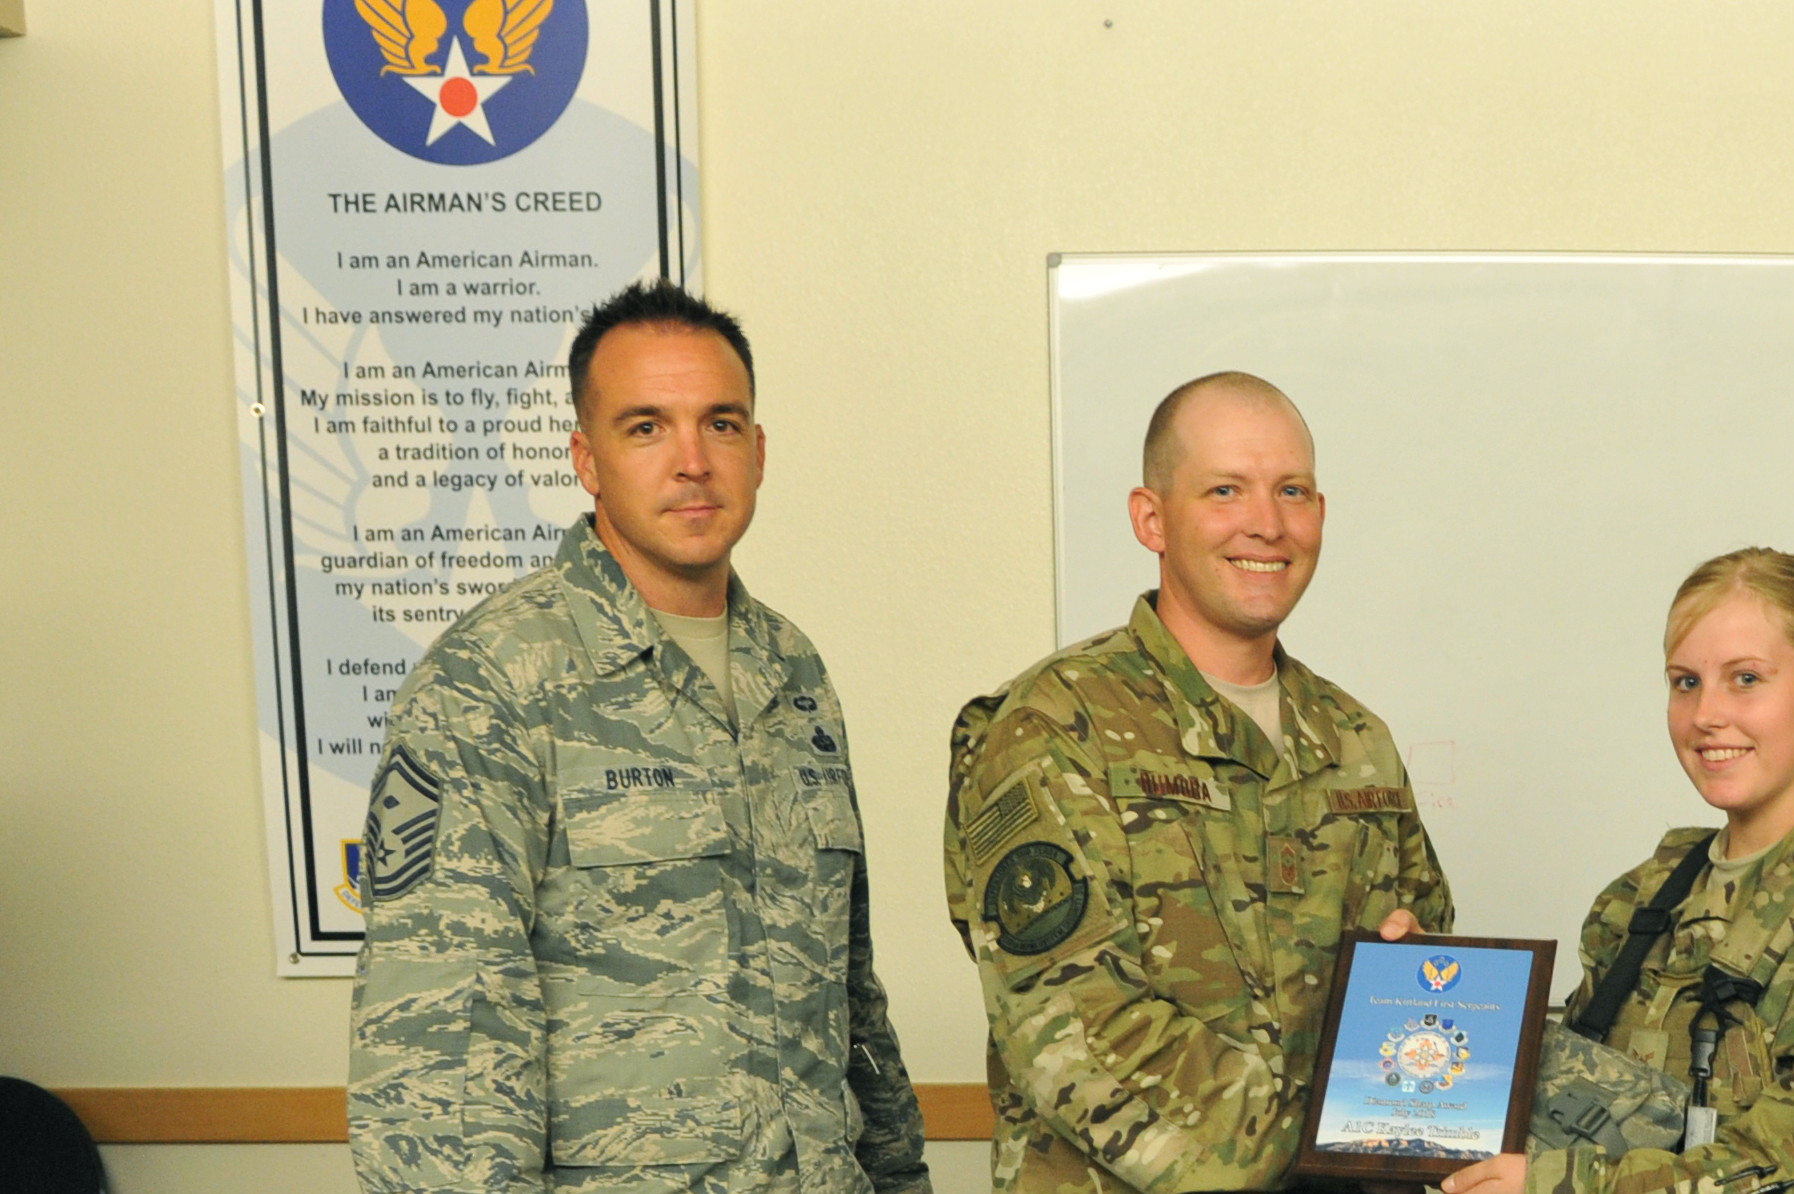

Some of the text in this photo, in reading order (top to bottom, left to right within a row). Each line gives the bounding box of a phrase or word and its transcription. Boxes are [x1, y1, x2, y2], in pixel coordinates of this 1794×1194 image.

[327, 192, 602, 214] THE AIRMAN'S CREED
[349, 255, 379, 269] am
[386, 255, 410, 269] an
[416, 250, 512, 268] American
[519, 250, 598, 268] Airman.
[409, 282, 439, 296] am
[446, 282, 457, 296] a
[463, 278, 540, 296] warrior.
[315, 307, 362, 324] have
[369, 306, 466, 324] answered
[473, 310, 503, 328] my
[510, 307, 590, 324] nation's
[355, 366, 385, 379] am
[392, 365, 416, 379] an
[422, 361, 518, 378] American
[524, 362, 569, 378] Airm
[300, 389, 329, 412] My
[336, 389, 415, 407] mission
[422, 388, 438, 405] is
[445, 389, 464, 406] to
[471, 388, 499, 410] fly,
[506, 388, 557, 410] fight,
[326, 420, 356, 434] am
[362, 416, 432, 434] faithful
[438, 417, 458, 433] to
[465, 420, 476, 433] a
[483, 415, 542, 437] proud
[378, 443, 569, 461] a tradition of honor
[372, 469, 578, 492] and a legacy of valor
[365, 529, 395, 542] am
[401, 528, 425, 542] an
[431, 524, 526, 542] American
[532, 524, 566, 541] Air
[321, 551, 553, 574] guardian of freedom an
[335, 577, 506, 600] my nation's swor
[373, 605, 396, 622] its
[339, 658, 406, 676] defend
[329, 738, 362, 755] will
[606, 767, 675, 790] BURTON
